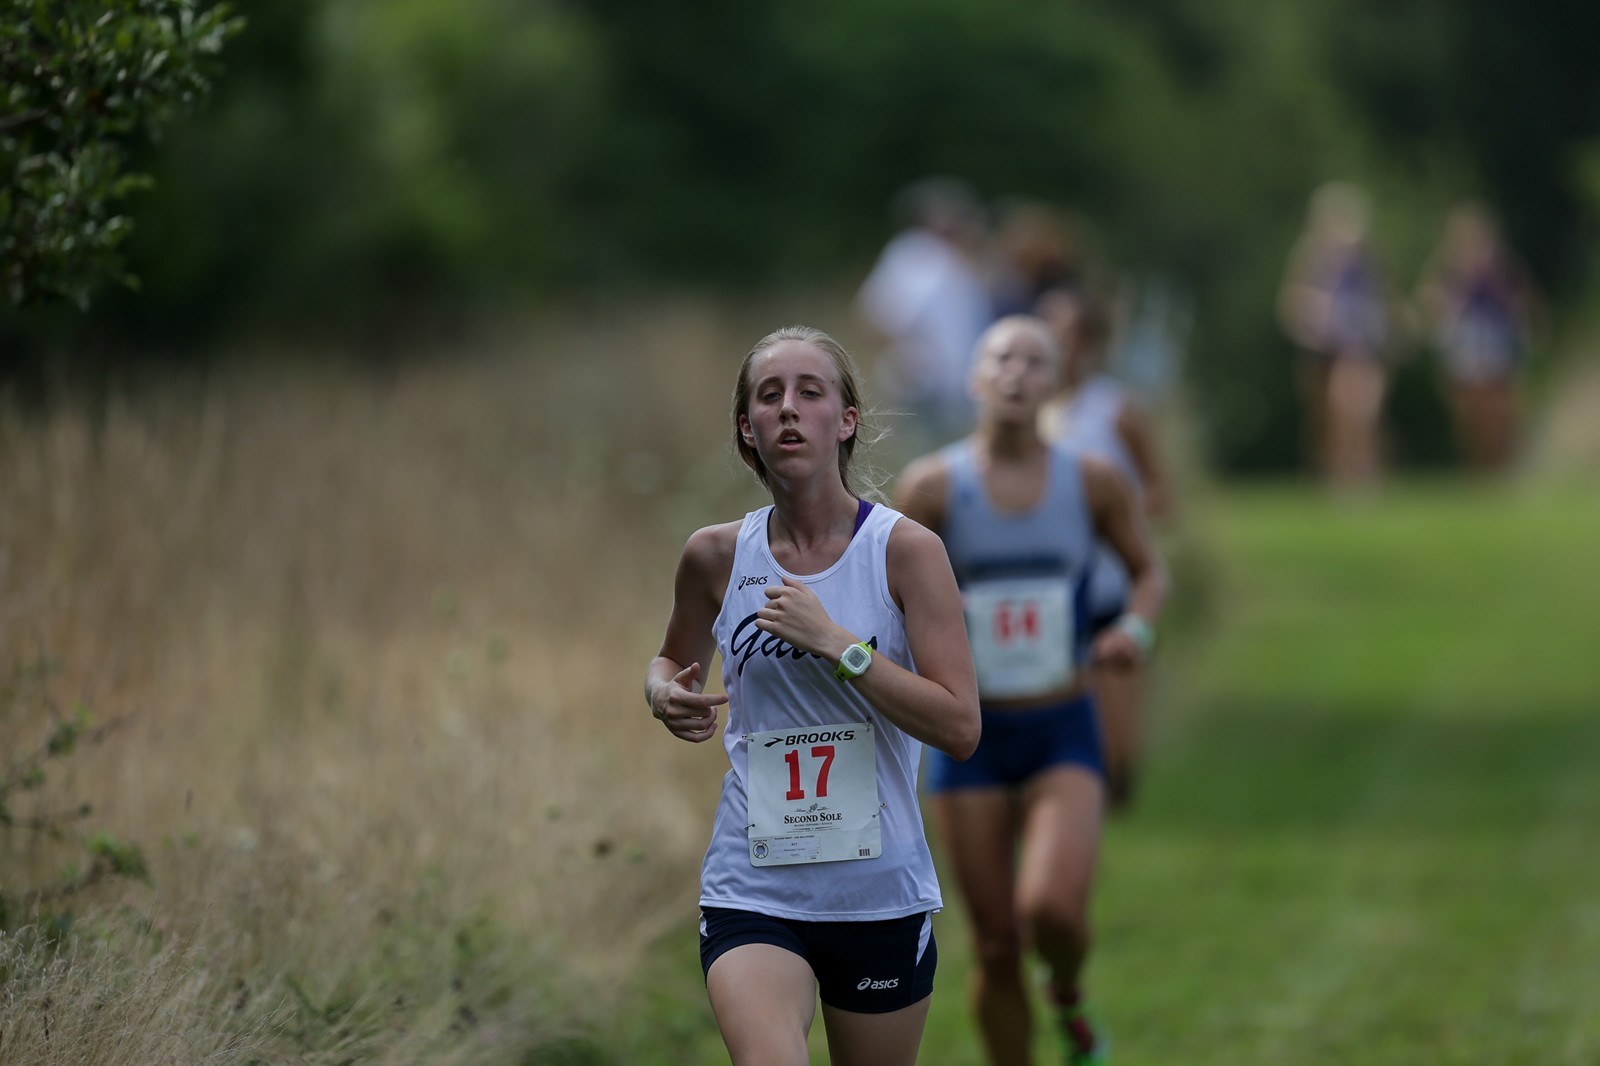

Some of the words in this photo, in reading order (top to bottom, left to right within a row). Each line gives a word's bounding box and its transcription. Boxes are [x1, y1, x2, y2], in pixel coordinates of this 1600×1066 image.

[785, 730, 855, 746] BROOKS
[785, 745, 835, 800] 17
[784, 815, 818, 824] SECOND
[819, 812, 843, 822] SOLE
[870, 978, 899, 990] asics
